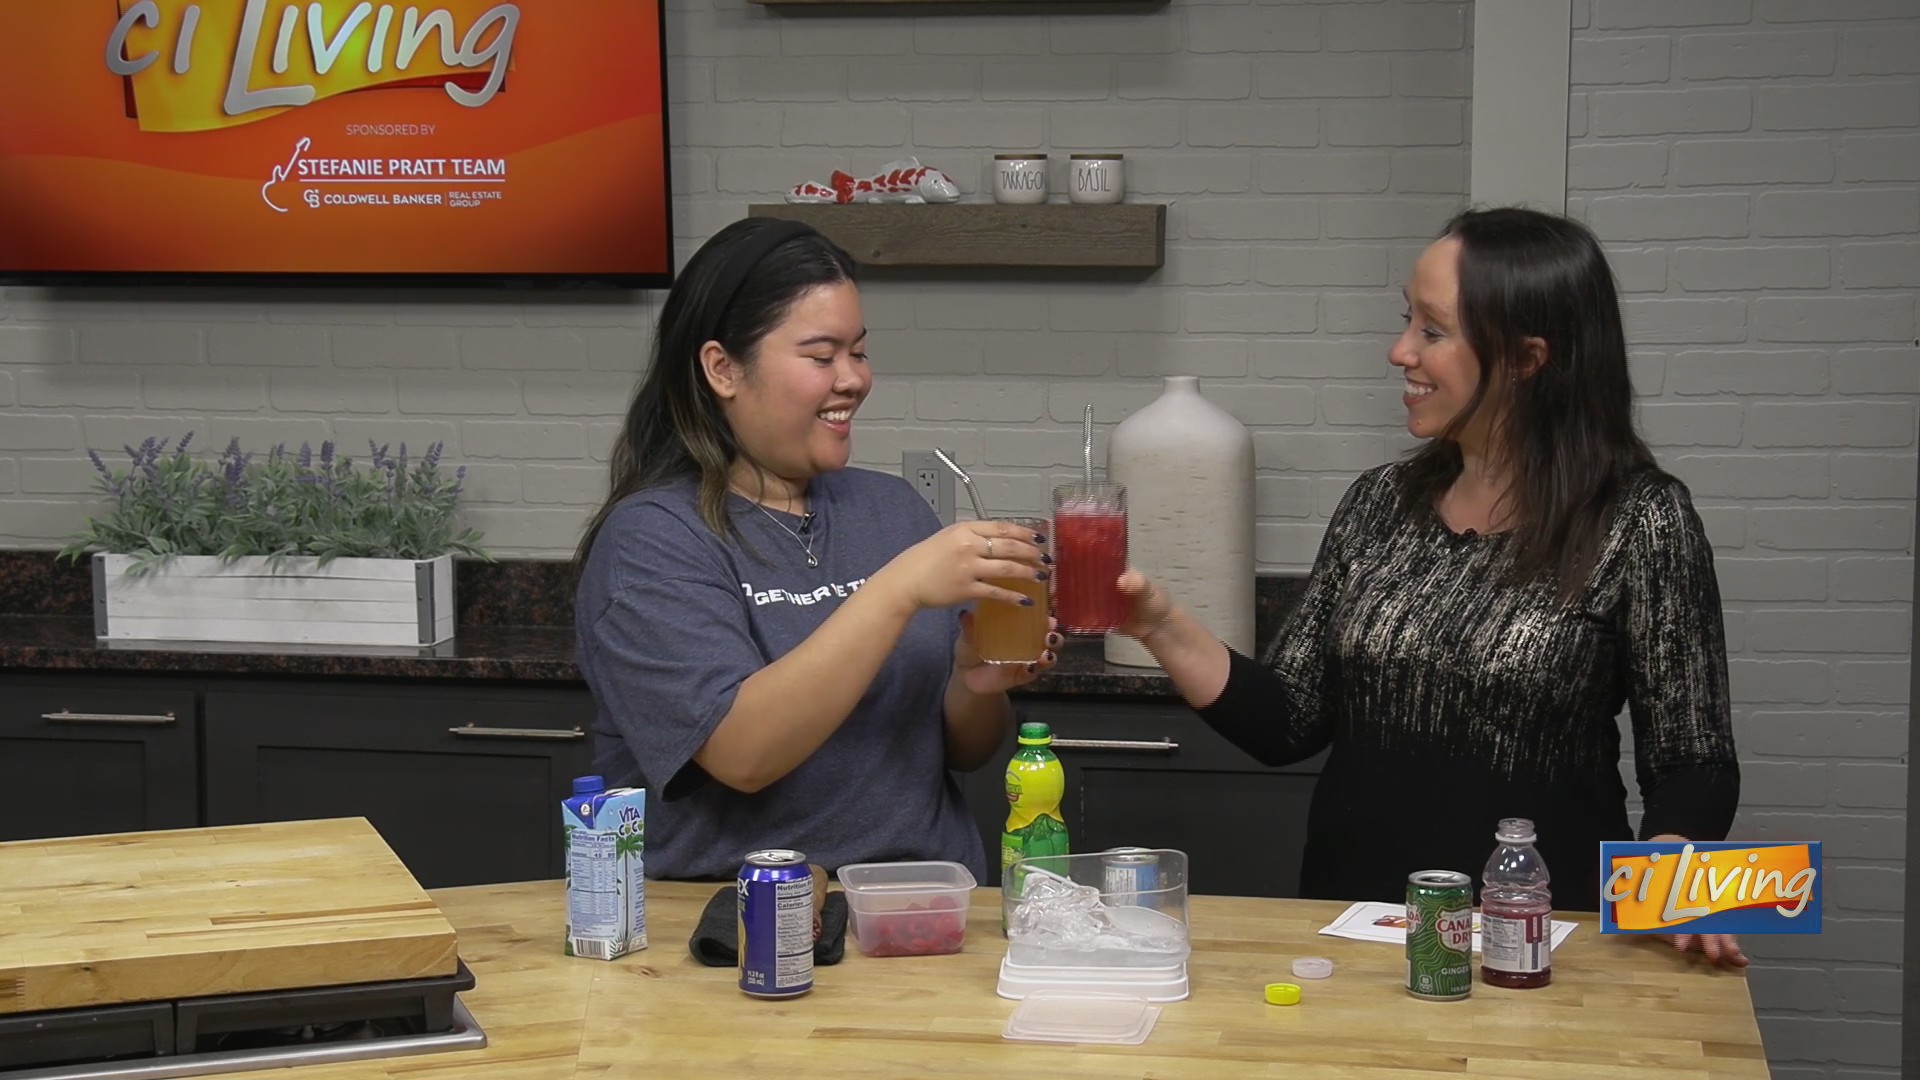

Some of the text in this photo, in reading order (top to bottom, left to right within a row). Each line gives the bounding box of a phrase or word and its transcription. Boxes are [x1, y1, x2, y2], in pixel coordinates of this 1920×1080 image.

[224, 0, 520, 115] Living
[346, 124, 436, 135] SPONSORED BY
[298, 158, 506, 175] STEFANIE PRATT TEAM
[1078, 167, 1111, 192] BASIL
[324, 193, 390, 205] COLDWELL
[393, 193, 442, 205] BANKER
[448, 191, 502, 200] REAL ESTATE
[450, 199, 481, 207] GROUP
[619, 806, 641, 823] VITA
[618, 819, 644, 836] COCO
[777, 882, 807, 891] Nutrition
